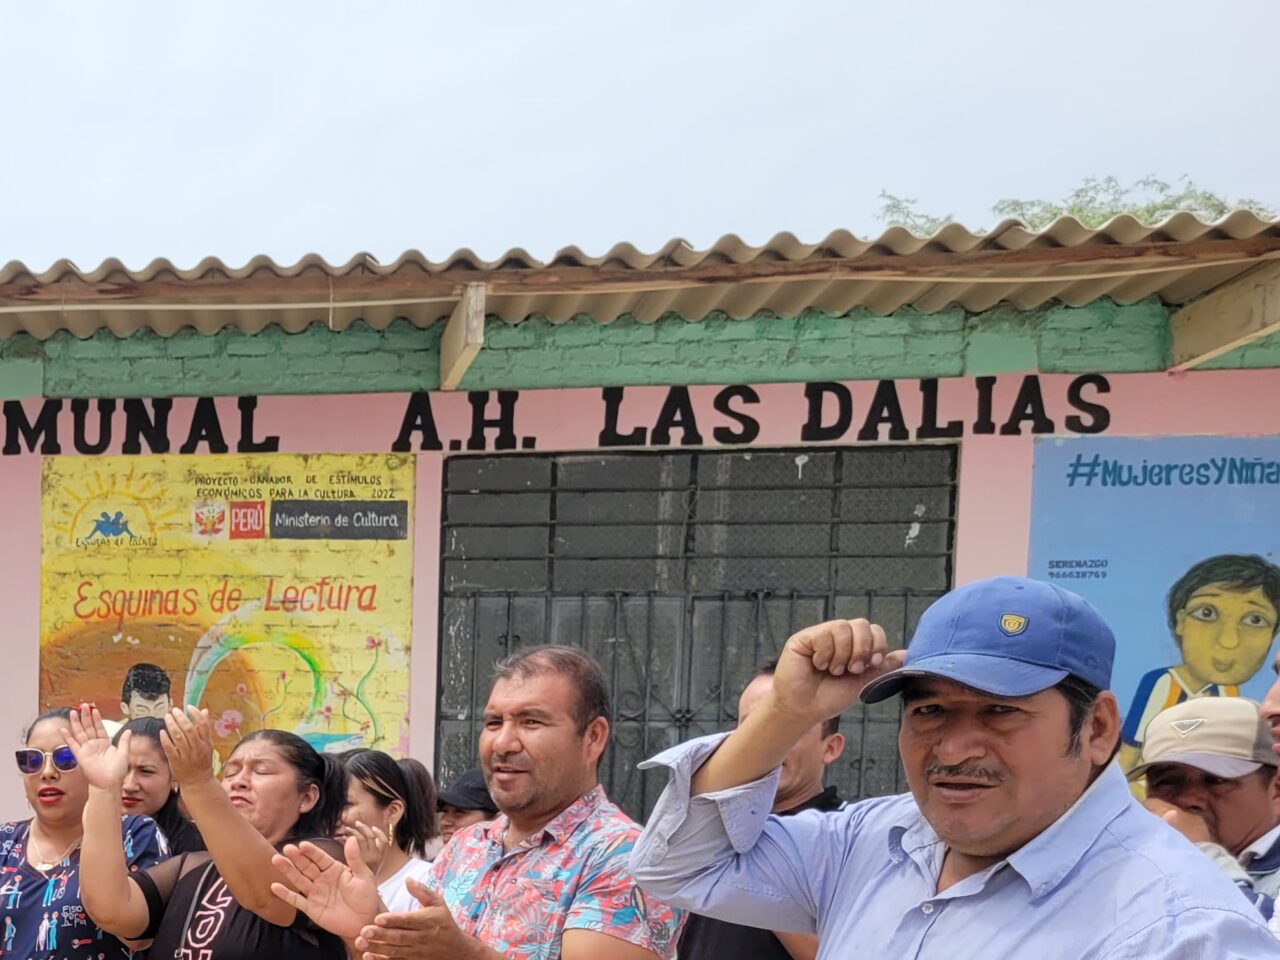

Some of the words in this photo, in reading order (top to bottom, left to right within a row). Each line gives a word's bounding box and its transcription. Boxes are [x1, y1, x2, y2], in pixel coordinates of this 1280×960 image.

[391, 391, 536, 452] A.H.
[598, 384, 761, 447] LAS
[800, 373, 1111, 442] DALIAS
[194, 475, 239, 486] PROYECTO
[305, 474, 318, 484] DE
[329, 472, 382, 486] ESTÍMULOS
[196, 486, 263, 500] ECONÓMICOS
[270, 488, 295, 499] PARA
[298, 488, 309, 499] LA
[314, 487, 356, 499] CULTURA
[371, 487, 396, 499] 2022
[231, 504, 263, 532] PERÚ
[274, 511, 331, 528] Ministerio
[334, 512, 349, 527] de
[352, 511, 400, 528] Cultura
[74, 580, 199, 628] Esquinas
[210, 579, 243, 613] de
[263, 577, 377, 613] Lectura
